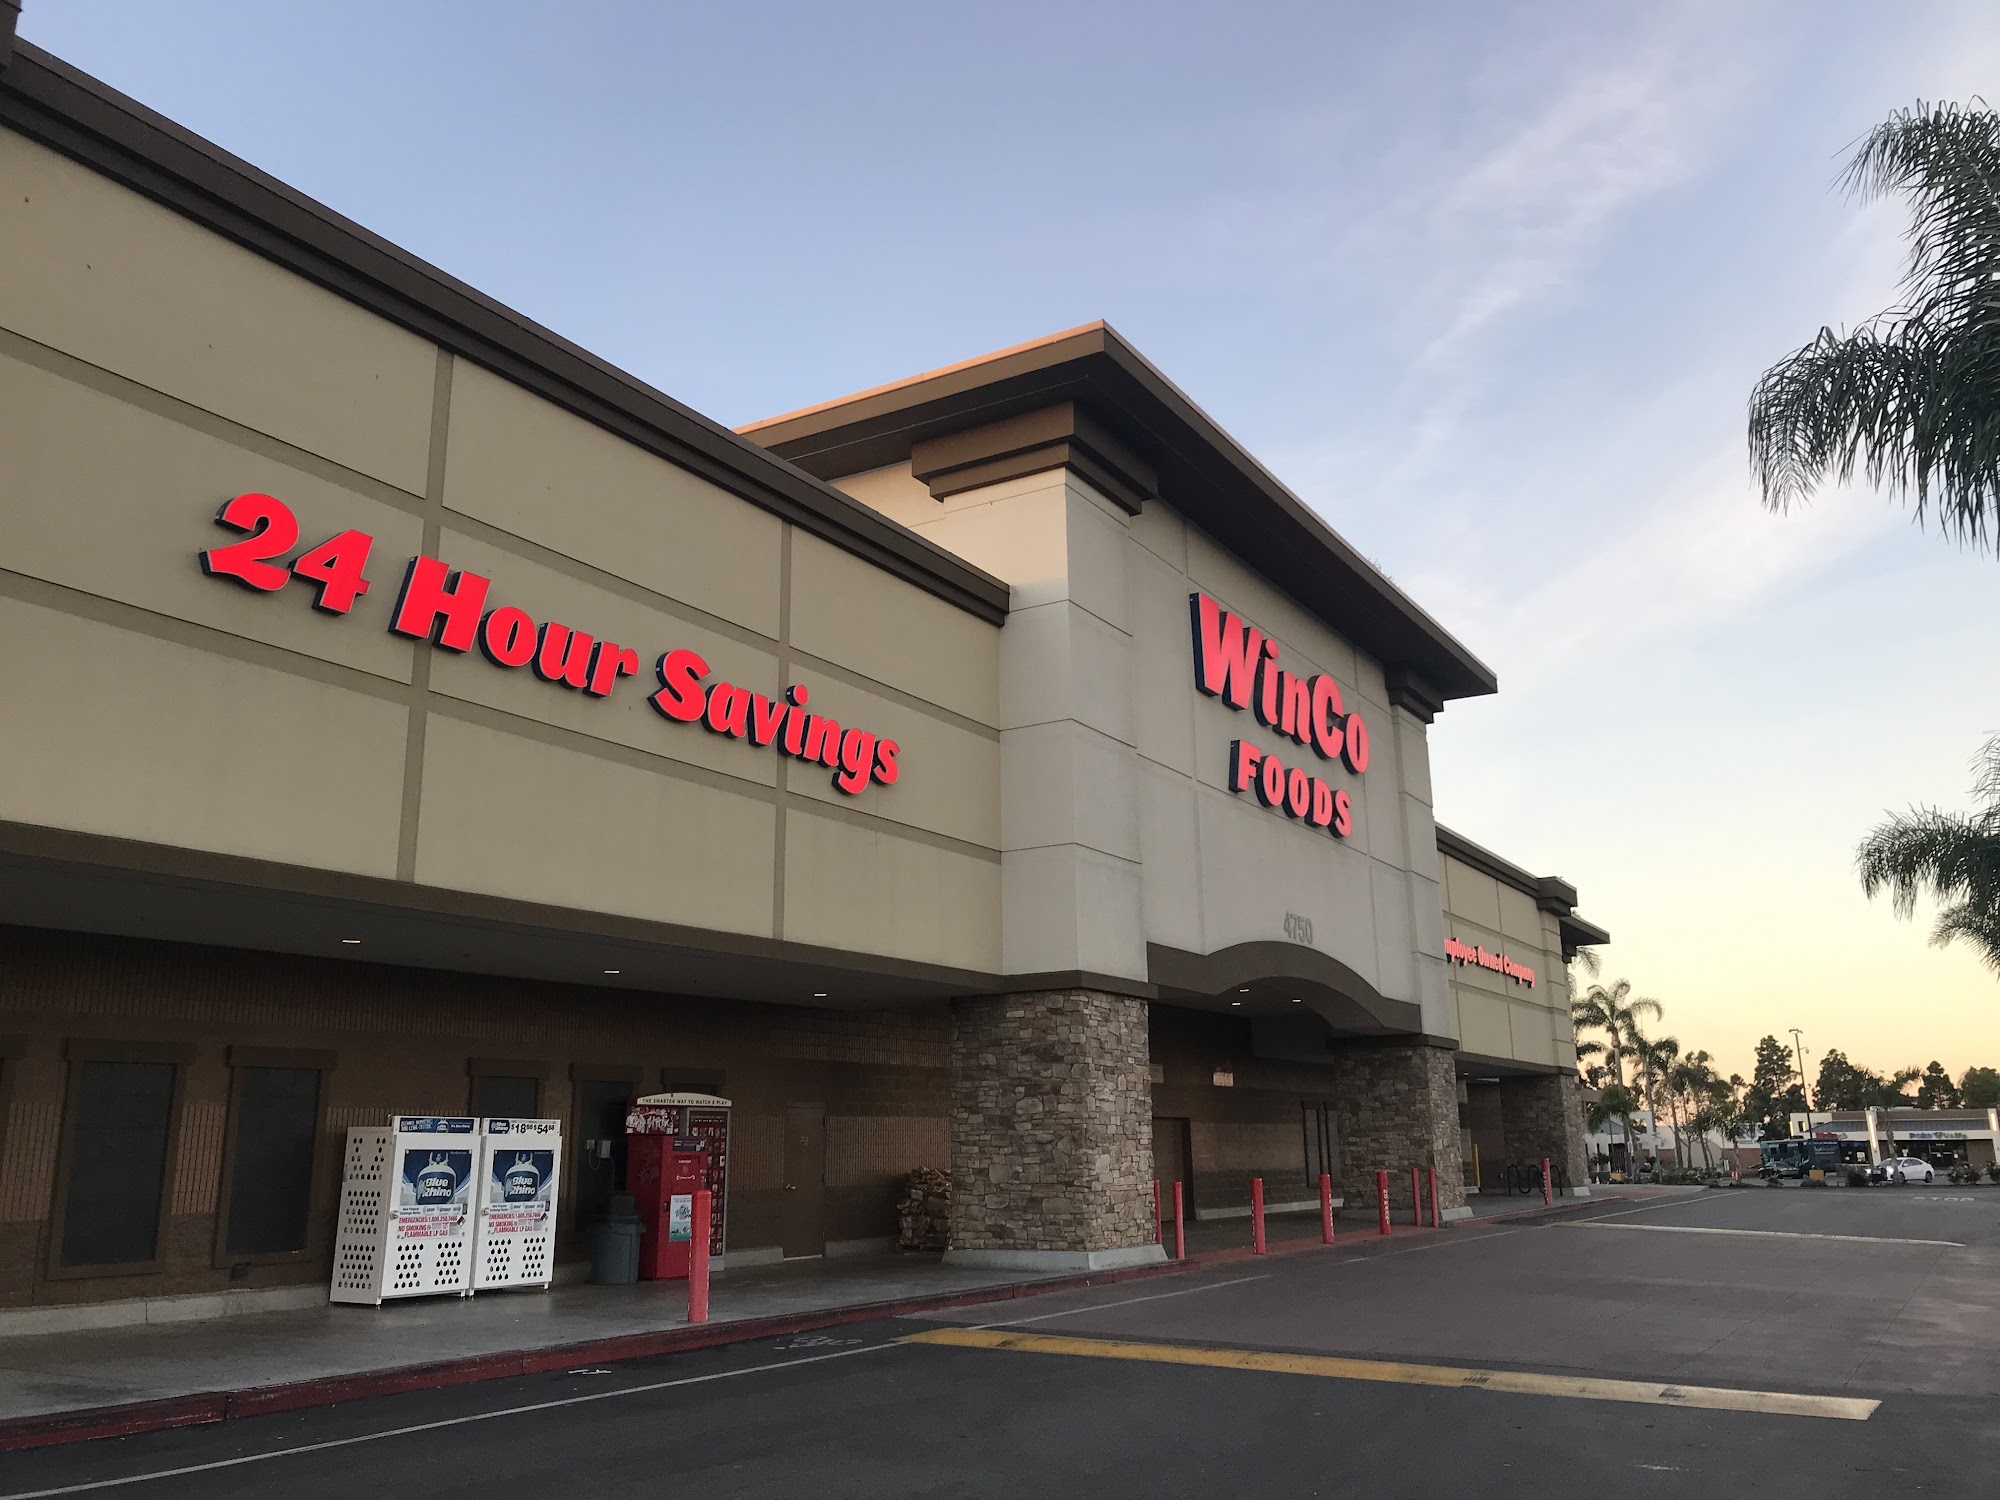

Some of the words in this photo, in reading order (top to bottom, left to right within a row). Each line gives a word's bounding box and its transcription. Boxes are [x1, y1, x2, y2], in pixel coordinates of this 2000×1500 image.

[200, 493, 374, 614] 24
[388, 555, 640, 698] Hour
[648, 648, 901, 795] Savings
[1190, 592, 1370, 775] WinCo
[1229, 739, 1353, 839] FOODS
[1283, 911, 1314, 945] 4750
[1477, 945, 1504, 973] Owned
[1503, 954, 1536, 989] Company
[422, 1186, 452, 1198] Rhino
[425, 1177, 449, 1187] Blue
[509, 1185, 536, 1195] Rhino
[512, 1175, 533, 1185] Blue
